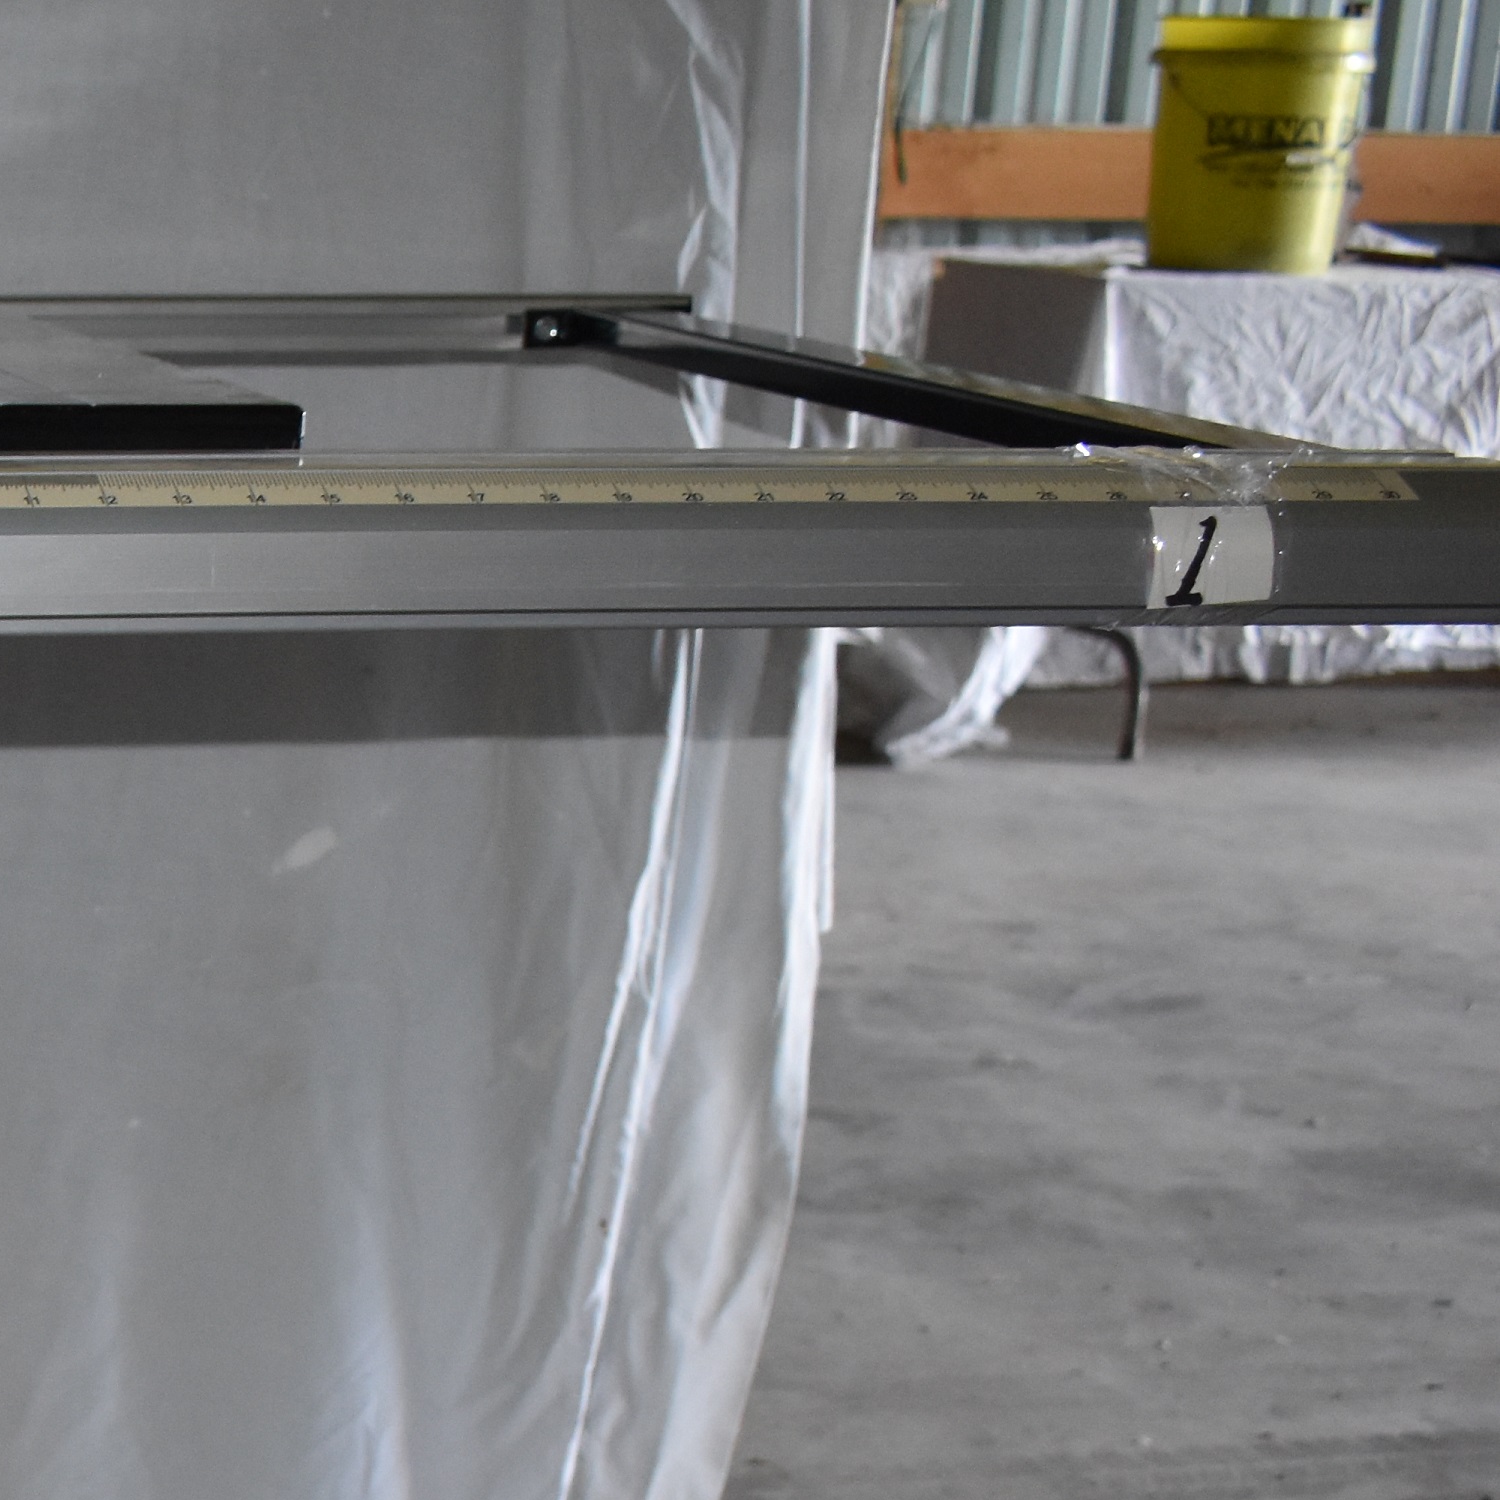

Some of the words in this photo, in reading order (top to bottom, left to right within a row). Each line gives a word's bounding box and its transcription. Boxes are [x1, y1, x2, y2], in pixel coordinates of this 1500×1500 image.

[24, 496, 40, 505] 11
[98, 496, 118, 505] 12
[172, 495, 192, 504] 13
[247, 495, 266, 504] 14
[321, 494, 341, 503] 15
[395, 493, 414, 502] 16
[467, 493, 485, 502] 17
[540, 493, 560, 502] 18
[613, 493, 632, 502] 19
[682, 492, 704, 501] 20
[754, 492, 775, 501] 21
[826, 492, 845, 501] 22
[967, 491, 988, 500] 24
[1165, 516, 1217, 606] 1
